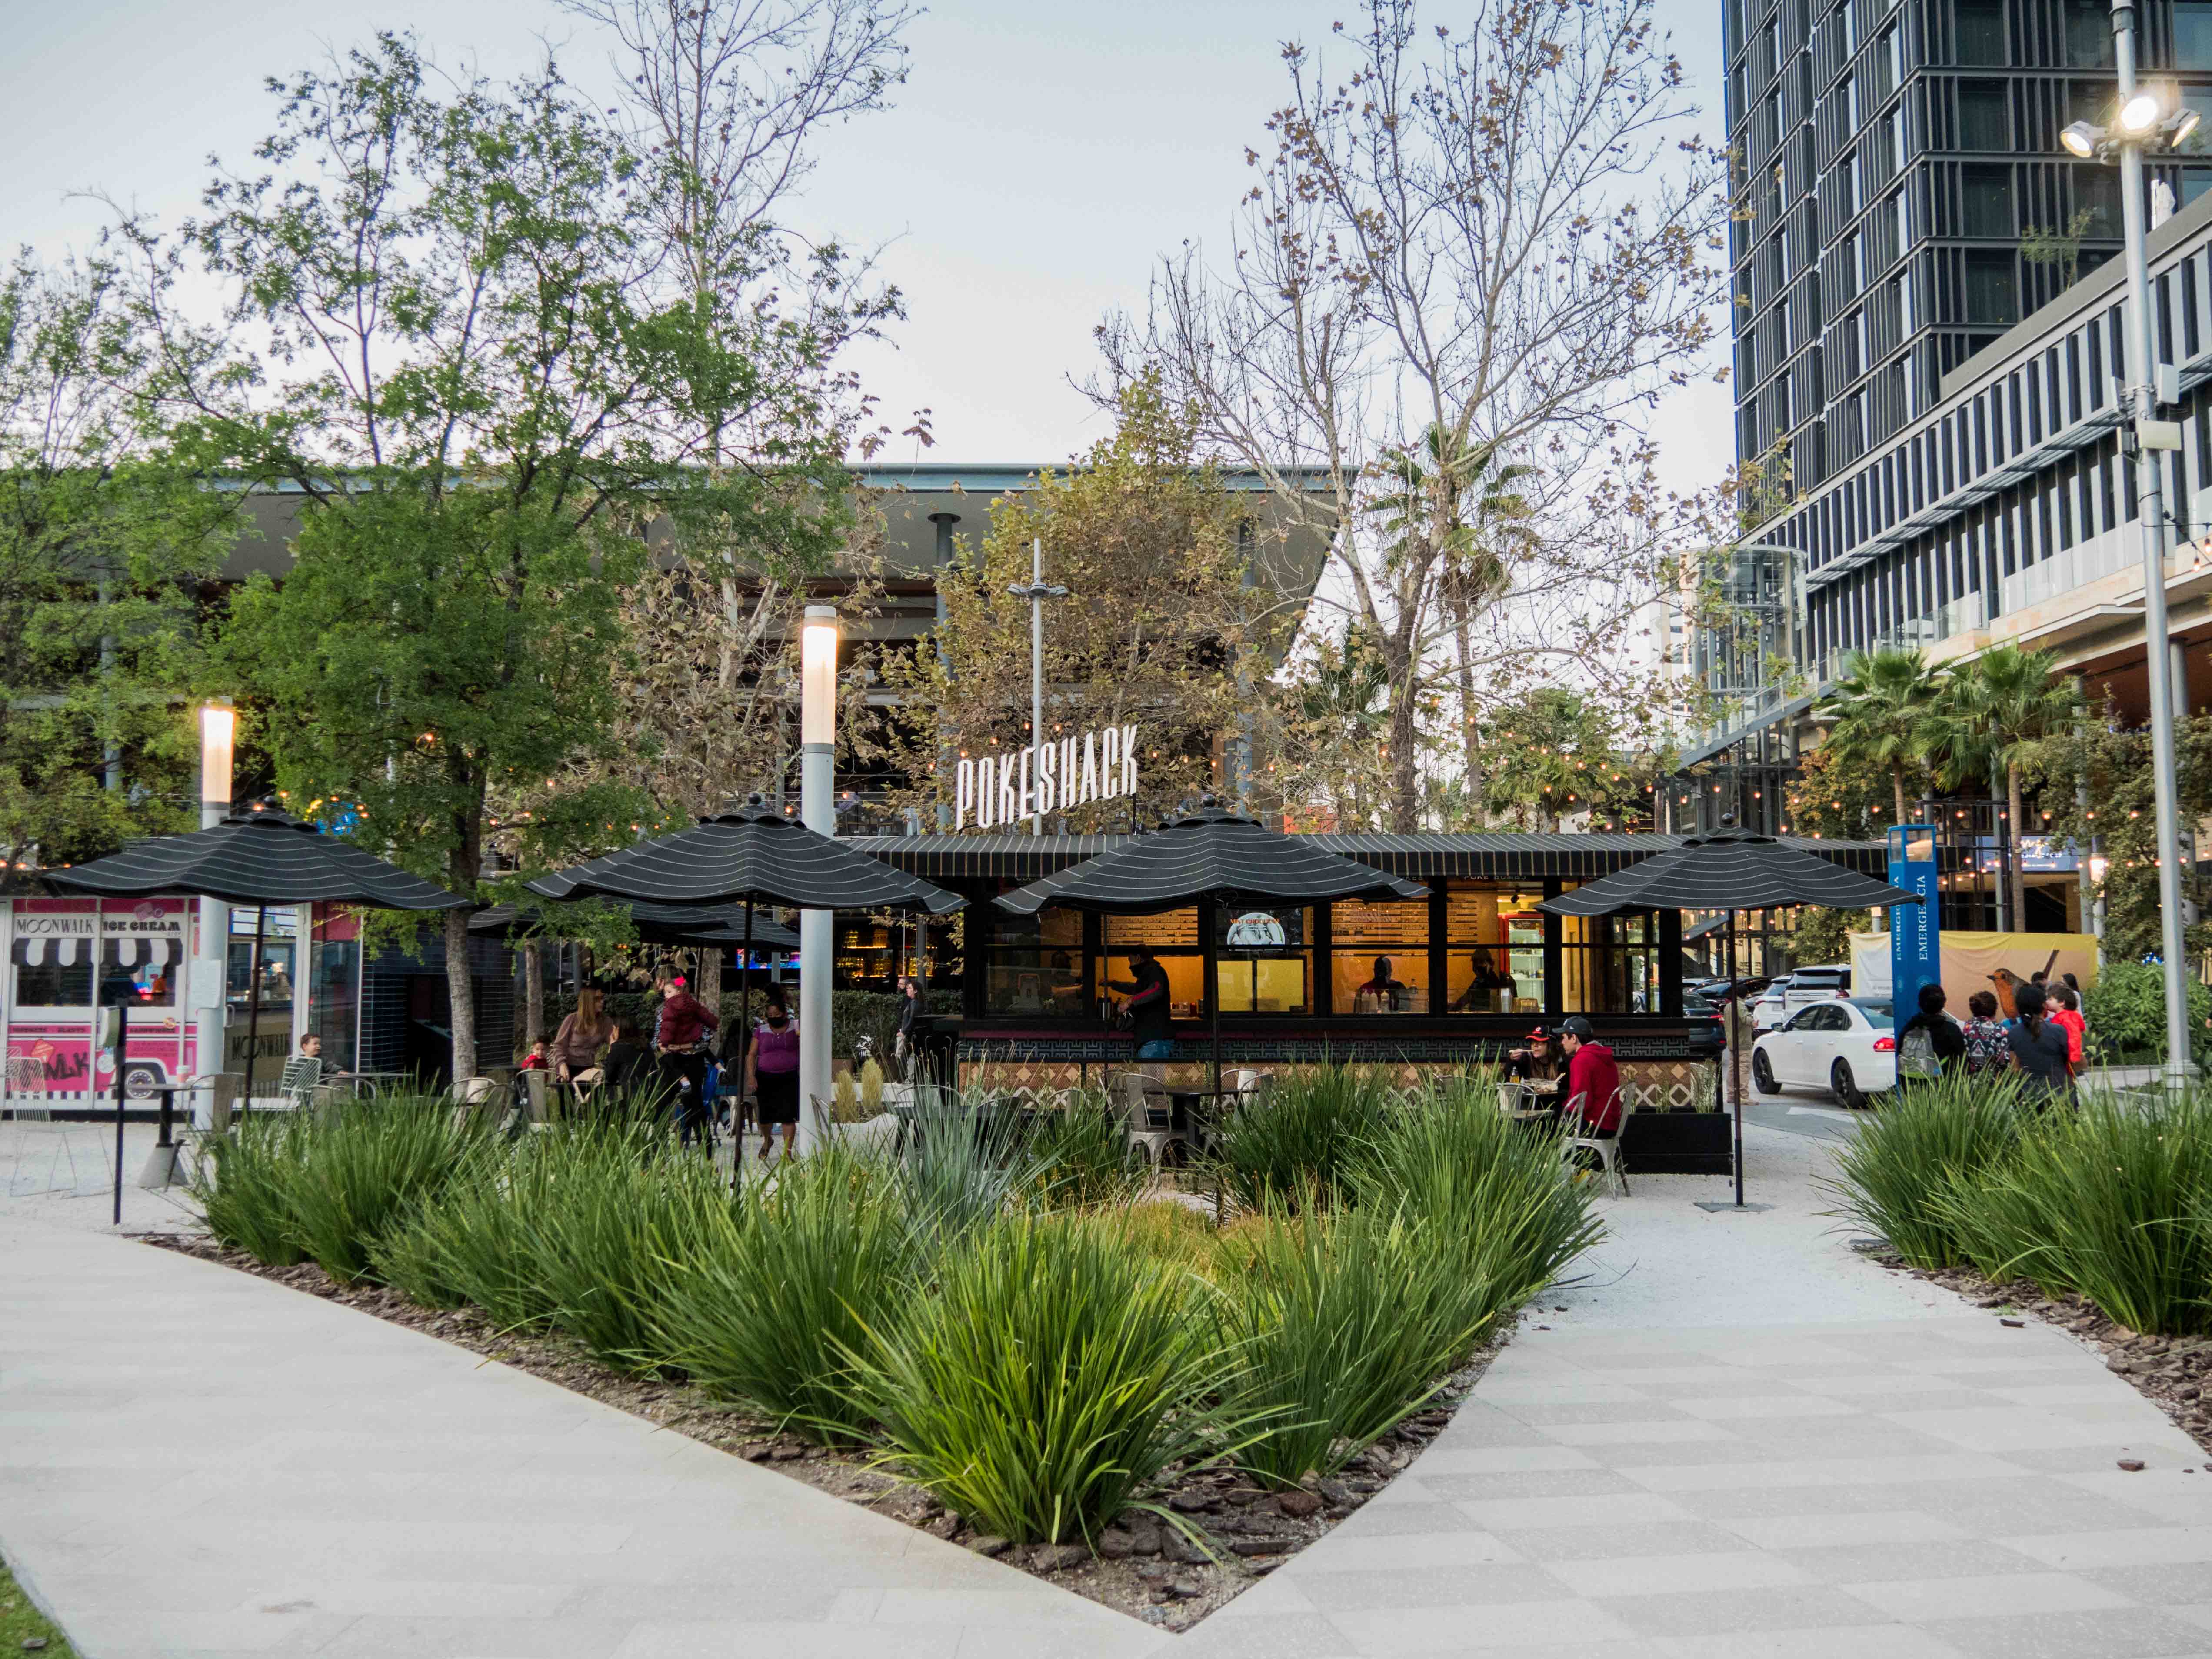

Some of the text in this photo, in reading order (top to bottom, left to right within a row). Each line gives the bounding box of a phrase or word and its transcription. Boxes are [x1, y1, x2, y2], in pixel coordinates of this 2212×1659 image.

[17, 919, 180, 933] MOONWALK ICE CREAM
[1917, 875, 1928, 960] EMERGECIA
